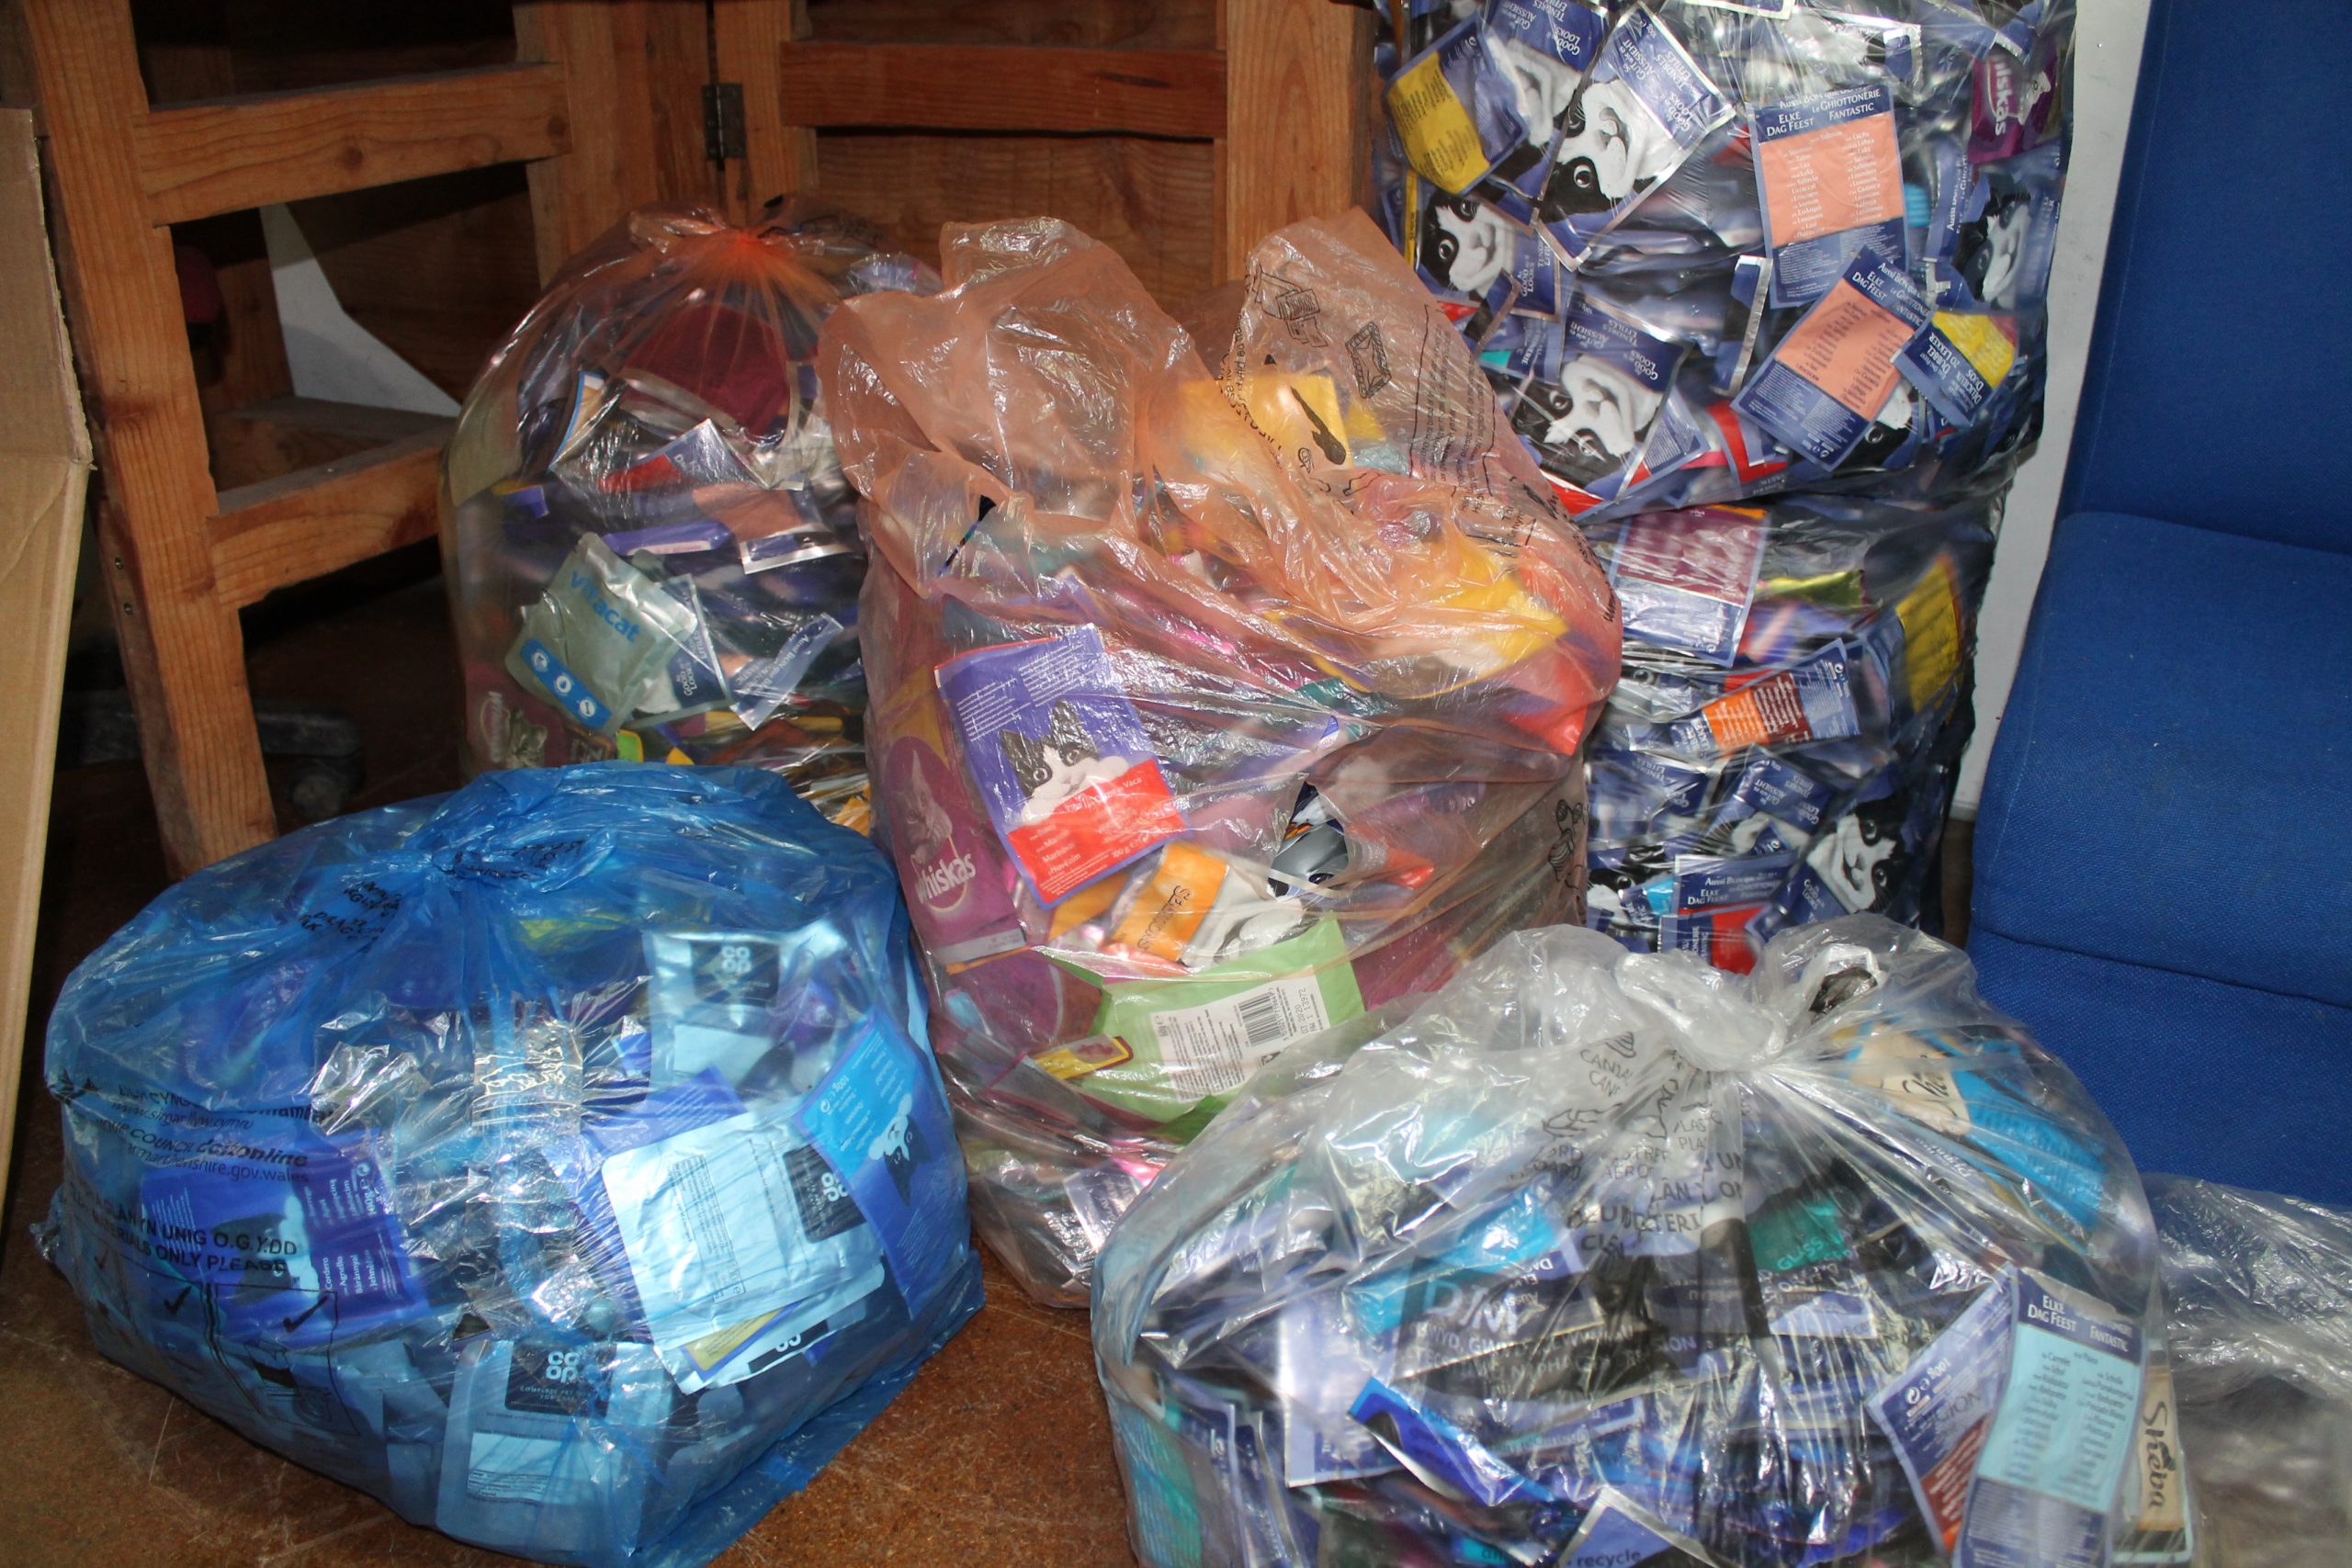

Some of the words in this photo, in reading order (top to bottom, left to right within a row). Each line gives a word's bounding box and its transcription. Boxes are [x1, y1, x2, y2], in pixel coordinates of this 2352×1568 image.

[1621, 36, 1656, 76] AUSSIEHT
[1628, 60, 1648, 82] GUT
[1653, 51, 1687, 90] TENDRES
[1667, 92, 1694, 123] LOOKS
[1820, 89, 1881, 111] GHIOTTONERIE
[1827, 101, 1875, 121] FANTASTIC
[1665, 104, 1691, 133] GOOD
[1765, 122, 1788, 137] DAG
[1787, 116, 1815, 132] FEEST
[1778, 109, 1802, 124] ELKE
[1850, 269, 1871, 288] DAG
[1865, 280, 1890, 302] FEEST
[1866, 269, 1886, 288] ELKE
[1921, 343, 1954, 375] DUBBEL
[1923, 331, 1956, 362] LEKKER
[1626, 349, 1657, 372] LOOKS
[1631, 361, 1659, 381] GOOD
[1962, 367, 1987, 391] DUOS
[570, 569, 641, 642] vitacat
[1122, 775, 1143, 790] Vaca
[1687, 895, 1706, 906] DAG
[320, 1256, 334, 1291] Cordero
[334, 1255, 349, 1287] Agnello
[2039, 1292, 2068, 1314] ELKE
[2024, 1301, 2052, 1324] DAG
[2047, 1310, 2078, 1333] FEEST
[2086, 1323, 2132, 1352] FANTASTIC
[2142, 1400, 2177, 1508] Sheba
[1576, 1546, 1643, 1568] recycle
